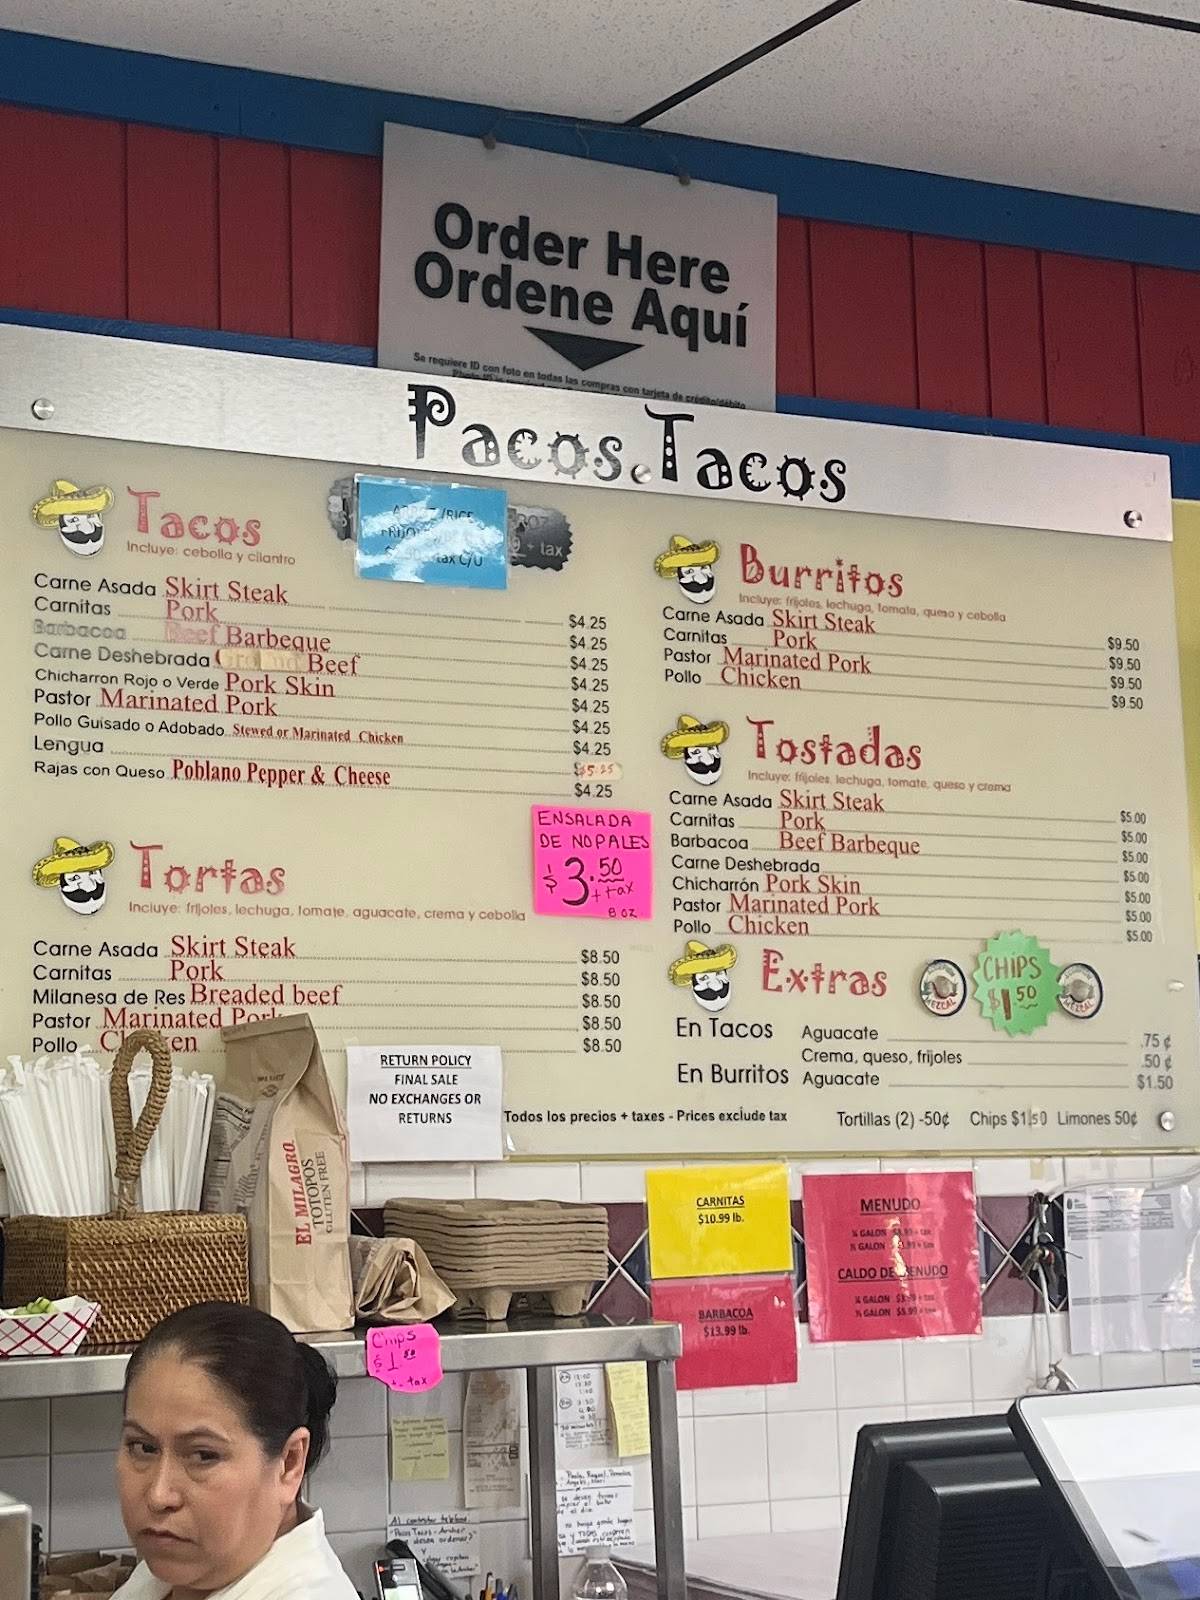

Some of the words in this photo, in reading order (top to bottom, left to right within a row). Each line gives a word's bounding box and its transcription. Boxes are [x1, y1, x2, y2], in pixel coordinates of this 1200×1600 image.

[434, 202, 588, 270] Order
[607, 230, 730, 294] Here
[414, 251, 613, 325] Ordene
[631, 288, 749, 351] Aquí
[429, 356, 467, 369] requiere
[470, 360, 480, 371] ID
[483, 365, 499, 374] con
[503, 366, 521, 377] foto
[523, 370, 535, 379] en
[537, 372, 562, 383] todas
[565, 375, 578, 385] las
[581, 379, 620, 392] compras
[623, 385, 639, 395] con
[642, 387, 670, 400] tarjeta
[407, 383, 623, 482] Pacos
[644, 404, 847, 503] Tacos
[127, 486, 262, 546] Tacos
[127, 541, 178, 557] Incluye:
[183, 546, 232, 560] cebolla
[236, 551, 243, 563] y
[248, 551, 296, 565] cilantro
[740, 543, 903, 598] Burritos
[34, 573, 92, 592] Carne
[98, 578, 156, 597] Asada
[166, 576, 219, 600] Skirt
[228, 580, 288, 604] Steak
[568, 614, 607, 630] $4.25
[34, 596, 111, 616] Carnitas
[167, 599, 218, 623] Pork
[33, 619, 127, 640] Barbacoa
[165, 621, 220, 645] Beef
[226, 625, 331, 653] Barbeque
[662, 606, 711, 623] Carne
[715, 610, 764, 626] Asada
[773, 608, 817, 630] Skirt
[824, 612, 876, 634] Steak
[1107, 636, 1139, 652] $9.50
[664, 628, 728, 645] Carnitas
[773, 630, 818, 650] Pork
[34, 642, 92, 661] Carne
[98, 645, 210, 668] Deshebrada
[308, 653, 360, 675] Beef
[35, 669, 118, 685] Chicharron
[124, 673, 157, 688] Rojo
[163, 678, 172, 687] o
[177, 677, 219, 691] Verde
[225, 672, 276, 694] Pork
[285, 677, 335, 698] Skin
[34, 689, 91, 706] Pastor
[100, 687, 217, 713] Marinated
[226, 694, 278, 717] Pork
[34, 713, 72, 728] Pollo
[78, 715, 140, 732] Guisado
[145, 722, 154, 732] o
[158, 720, 225, 736] Adobado
[233, 723, 273, 738] Stewed
[276, 728, 289, 738] or
[292, 726, 350, 742] Marinated
[359, 731, 404, 745] Chicken
[34, 735, 104, 756] Lengua
[746, 716, 921, 770] Tostadas
[34, 761, 78, 778] Rajas
[83, 766, 110, 776] con
[115, 765, 165, 780] Queso
[172, 758, 241, 783] Poblano
[247, 763, 306, 788] Pepper
[311, 765, 325, 784] &
[335, 765, 391, 786] Cheese
[538, 810, 632, 828] ENSALADA
[1120, 810, 1146, 825] $5.00
[539, 834, 561, 848] DE
[572, 834, 650, 850] NOPALES
[671, 833, 749, 850] Barbacoa
[779, 830, 827, 850] Beef
[831, 833, 920, 859] Barbeque
[129, 840, 286, 896] Tortas
[671, 854, 720, 870] Carne
[725, 857, 820, 873] Deshebrada
[606, 881, 634, 896] tax
[672, 876, 759, 892] Chicharrón
[766, 873, 810, 894] Pork
[818, 875, 861, 895] Skin
[33, 940, 92, 957] Carne
[98, 941, 158, 957] Asada
[171, 935, 227, 958] Skirt
[235, 935, 296, 958] Steak
[580, 949, 620, 964] $8.50
[33, 964, 112, 981] Carnitas
[171, 959, 224, 981] Pork
[762, 948, 888, 998] Extras
[983, 955, 1042, 982] CHIPS
[33, 989, 117, 1005] Milanesa
[123, 989, 148, 1004] de
[155, 990, 185, 1005] Res
[190, 983, 284, 1006] Breaded
[293, 984, 343, 1006] beef
[33, 1013, 91, 1029] Pastor
[103, 1007, 222, 1029] Marinated
[33, 1037, 78, 1053] Pollo
[676, 1018, 701, 1037] En
[708, 1018, 773, 1039] Tacos
[801, 1025, 878, 1043] Aguacate
[1140, 1033, 1160, 1048] .75
[380, 1054, 428, 1067] RETURN
[432, 1055, 472, 1067] POLICY
[801, 1048, 858, 1064] Crema,
[863, 1050, 912, 1066] queso,
[917, 1050, 962, 1066] frijoles
[1141, 1054, 1160, 1069] .50
[394, 1074, 428, 1085] FINAL
[431, 1074, 458, 1085] SALE
[678, 1064, 702, 1083] En
[711, 1064, 789, 1084] Burritos
[802, 1072, 880, 1089] Aguacate
[1137, 1075, 1174, 1090] $1.50
[369, 1093, 388, 1105] NO
[391, 1093, 461, 1105] EXCHANGES
[465, 1093, 481, 1105] OR
[399, 1112, 452, 1124] RETURNS
[504, 1110, 543, 1123] Todos
[547, 1110, 566, 1123] los
[570, 1110, 617, 1124] precios
[620, 1112, 628, 1121] +
[632, 1111, 665, 1123] taxes
[677, 1110, 715, 1122] Prices
[718, 1108, 766, 1122] exclude
[769, 1111, 787, 1122] tax
[837, 1111, 891, 1127] Tortillas
[895, 1111, 915, 1129] (2)
[919, 1111, 950, 1128] -50¢
[970, 1111, 1008, 1128] Chips
[1057, 1111, 1111, 1127] Limones
[1115, 1111, 1138, 1127] 50¢
[315, 1151, 328, 1177] FREE
[301, 1159, 327, 1229] TOTOPOS
[697, 1195, 745, 1207] CARNITAS
[861, 1199, 921, 1212] MENUDO
[320, 1180, 334, 1234] GLUTEN
[698, 1213, 730, 1225] $10.99
[733, 1212, 744, 1223] lb.
[296, 1226, 312, 1246] EL
[838, 1268, 877, 1280] CALDO
[880, 1266, 894, 1278] DE
[698, 1308, 753, 1320] BARBACOA
[704, 1326, 734, 1338] $13.99
